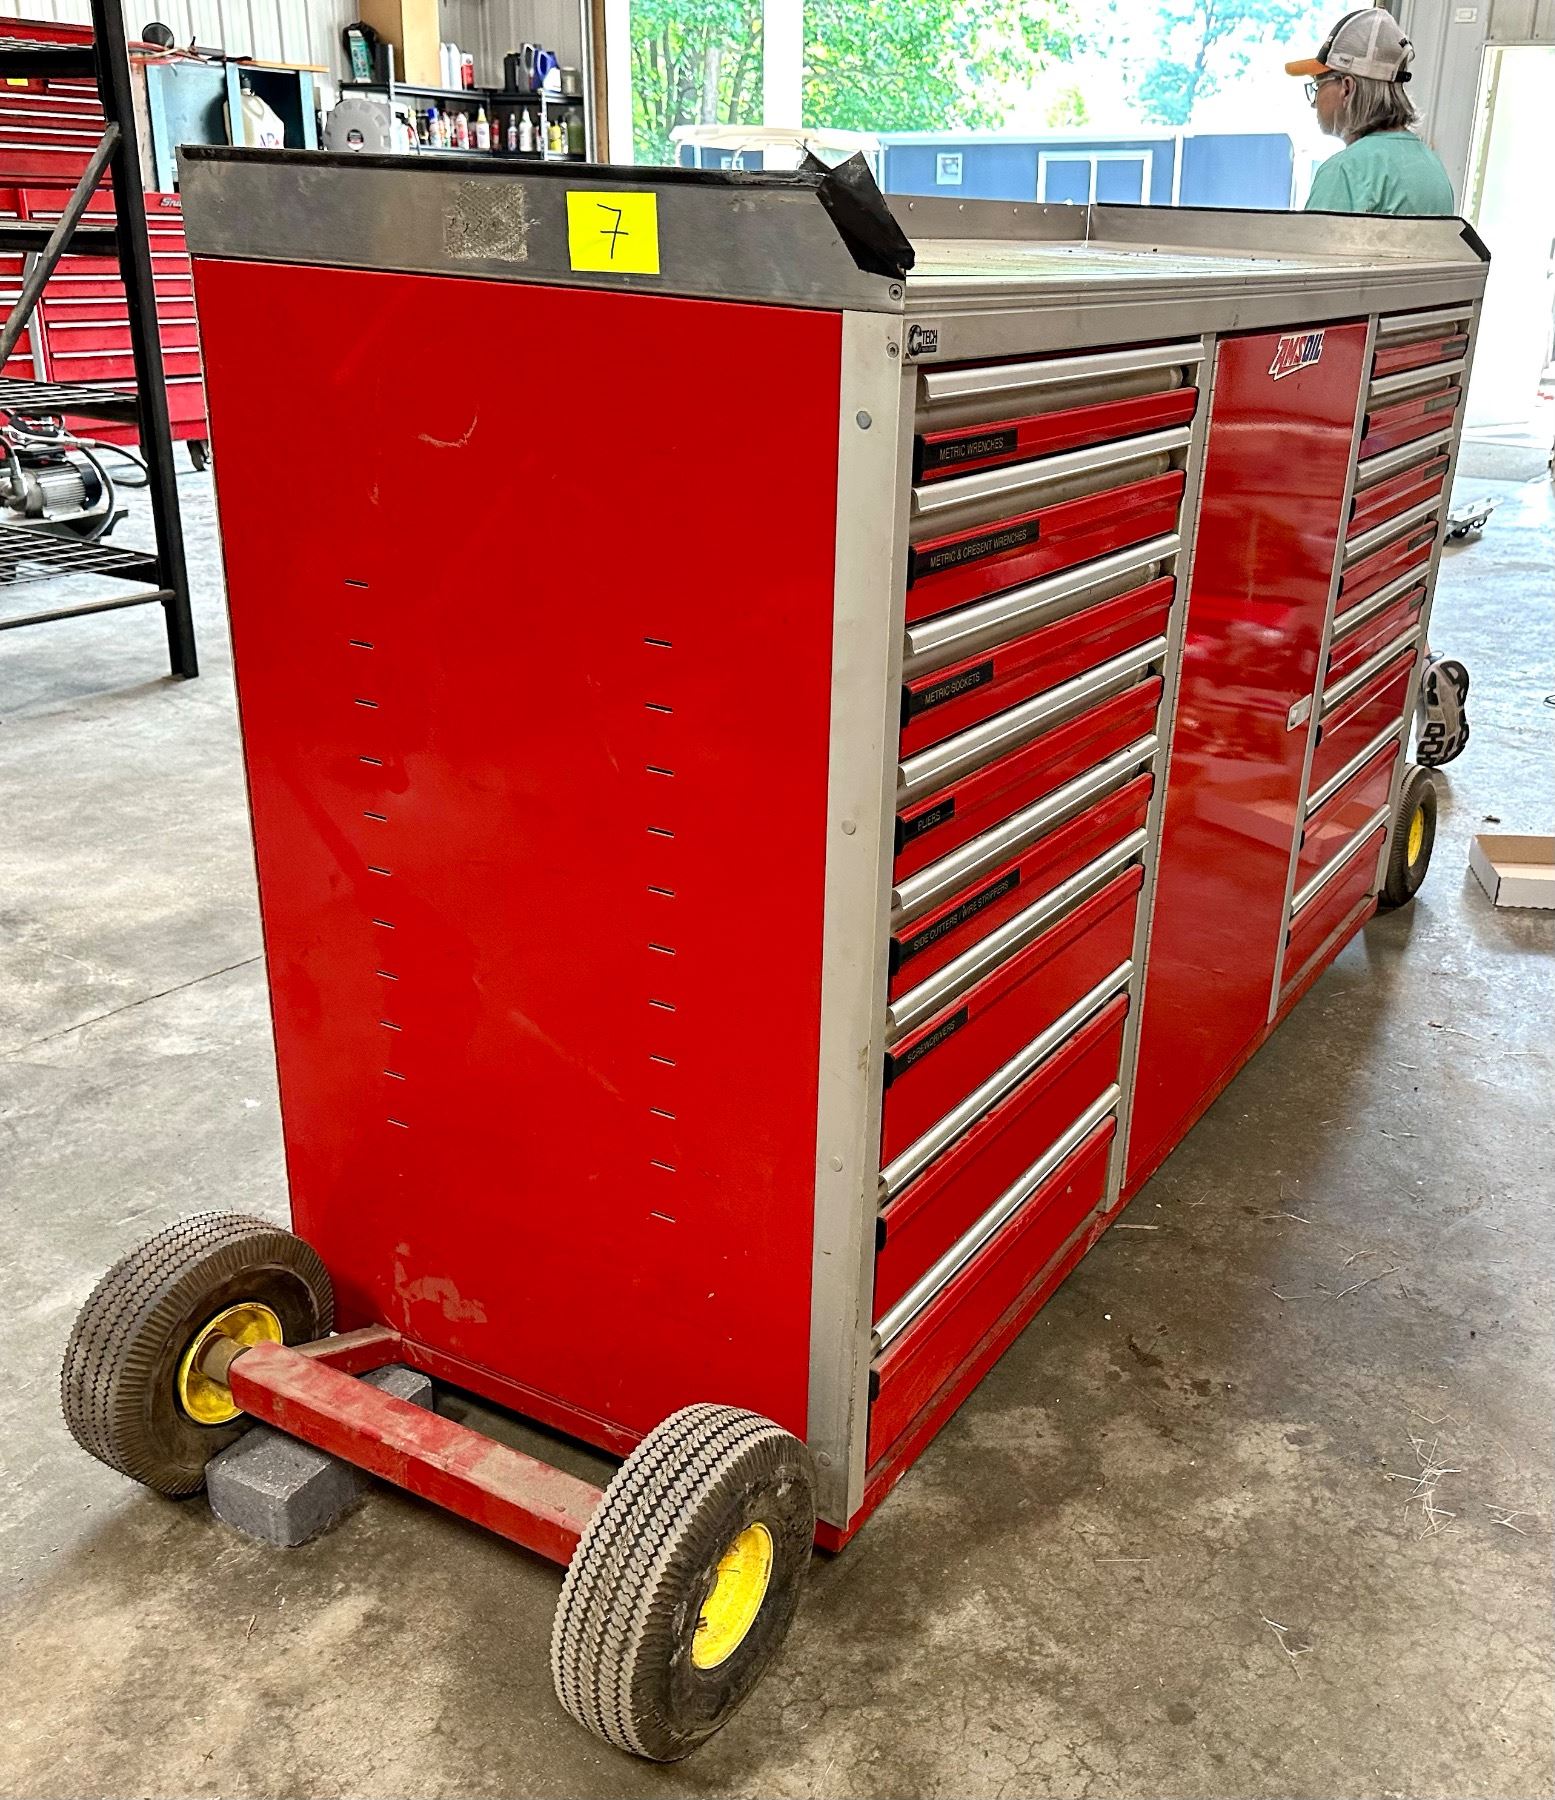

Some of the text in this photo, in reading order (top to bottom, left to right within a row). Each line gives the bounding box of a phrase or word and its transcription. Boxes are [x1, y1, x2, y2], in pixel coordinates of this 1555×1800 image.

[597, 203, 629, 259] 7
[1270, 332, 1324, 377] AMSOIL
[940, 437, 1004, 460] METRIC WRENCHES
[930, 550, 956, 568] METRIC
[963, 539, 993, 558] CRESENT
[994, 529, 1027, 548] WRENCHES
[924, 671, 981, 705] METRIC SOCKETS
[917, 810, 941, 831] PLIERS
[914, 933, 930, 951] SIDE
[930, 913, 958, 940] CUTTERS
[978, 880, 1009, 907] STRIPPERS
[907, 1020, 956, 1064] SCREWDRIVERS
